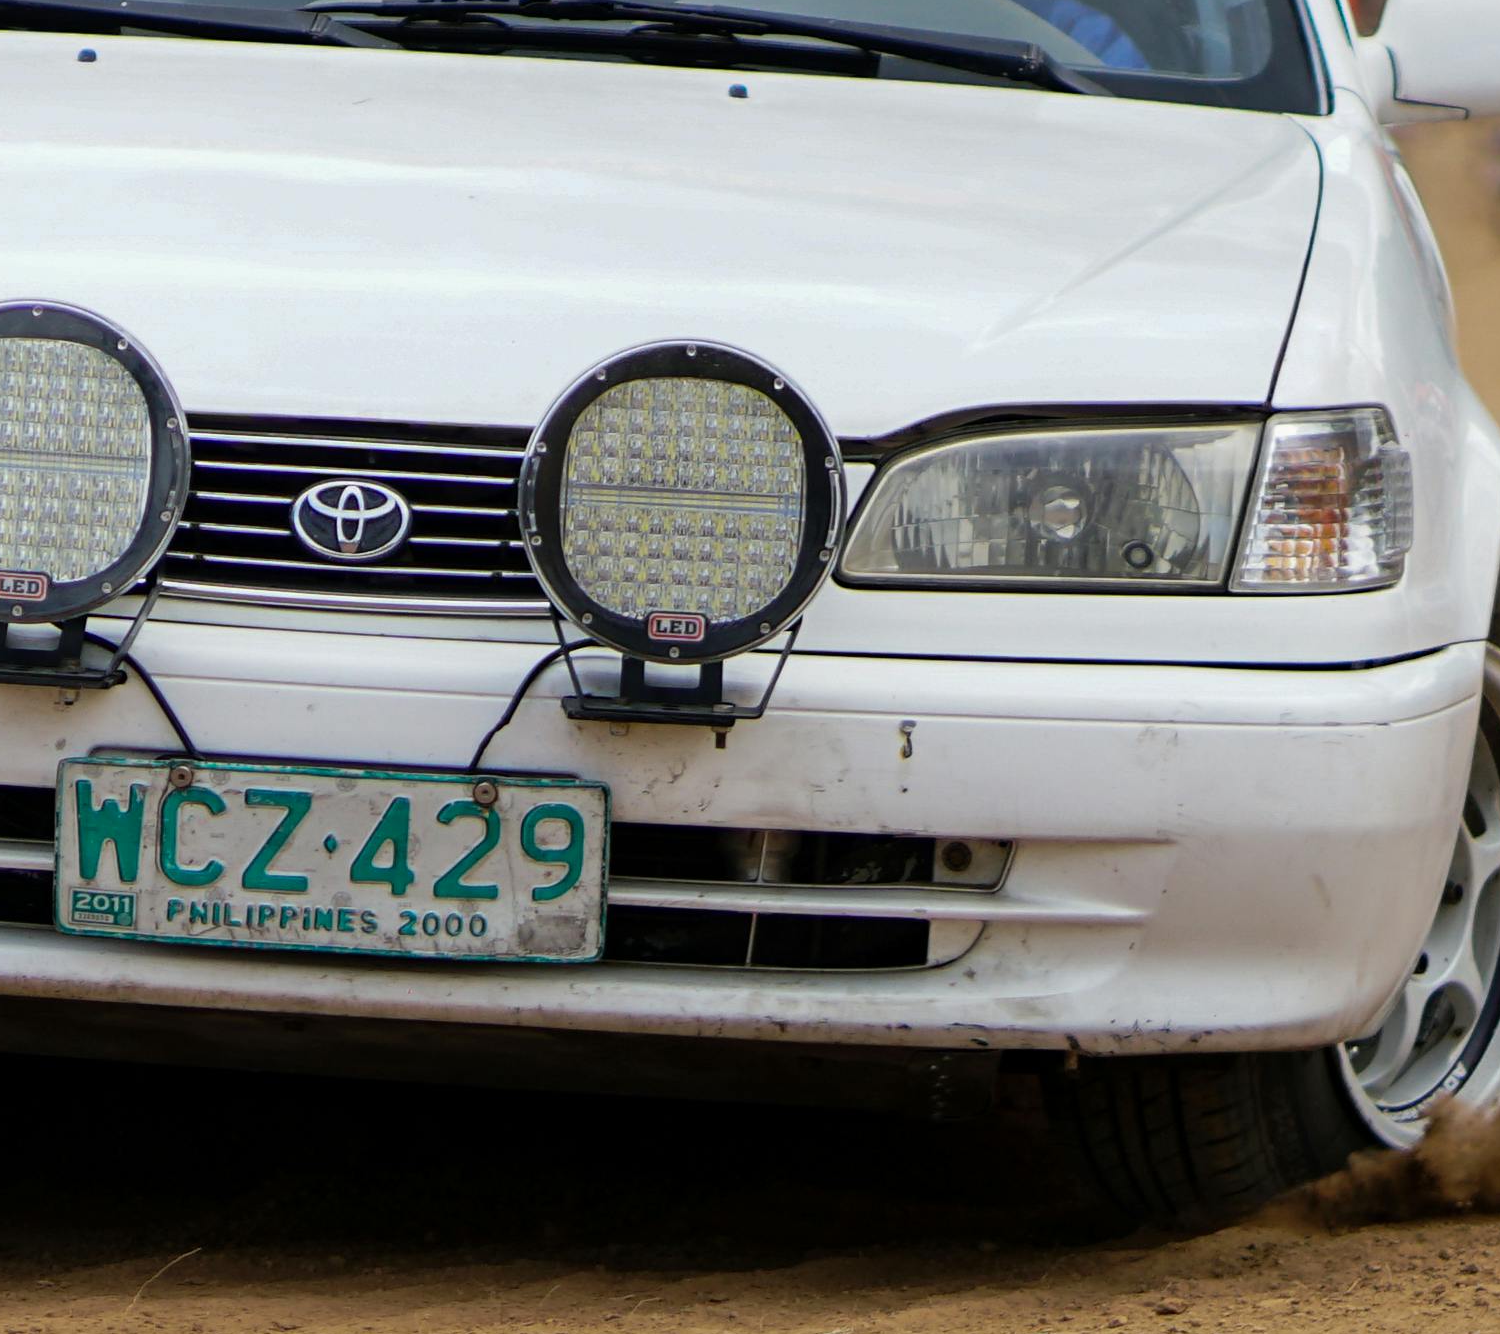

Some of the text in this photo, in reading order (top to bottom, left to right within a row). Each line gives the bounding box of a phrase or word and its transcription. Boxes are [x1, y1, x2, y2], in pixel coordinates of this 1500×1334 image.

[655, 619, 698, 635] LED
[75, 893, 130, 913] 2011
[166, 898, 488, 937] PHILIPPINES 2000
